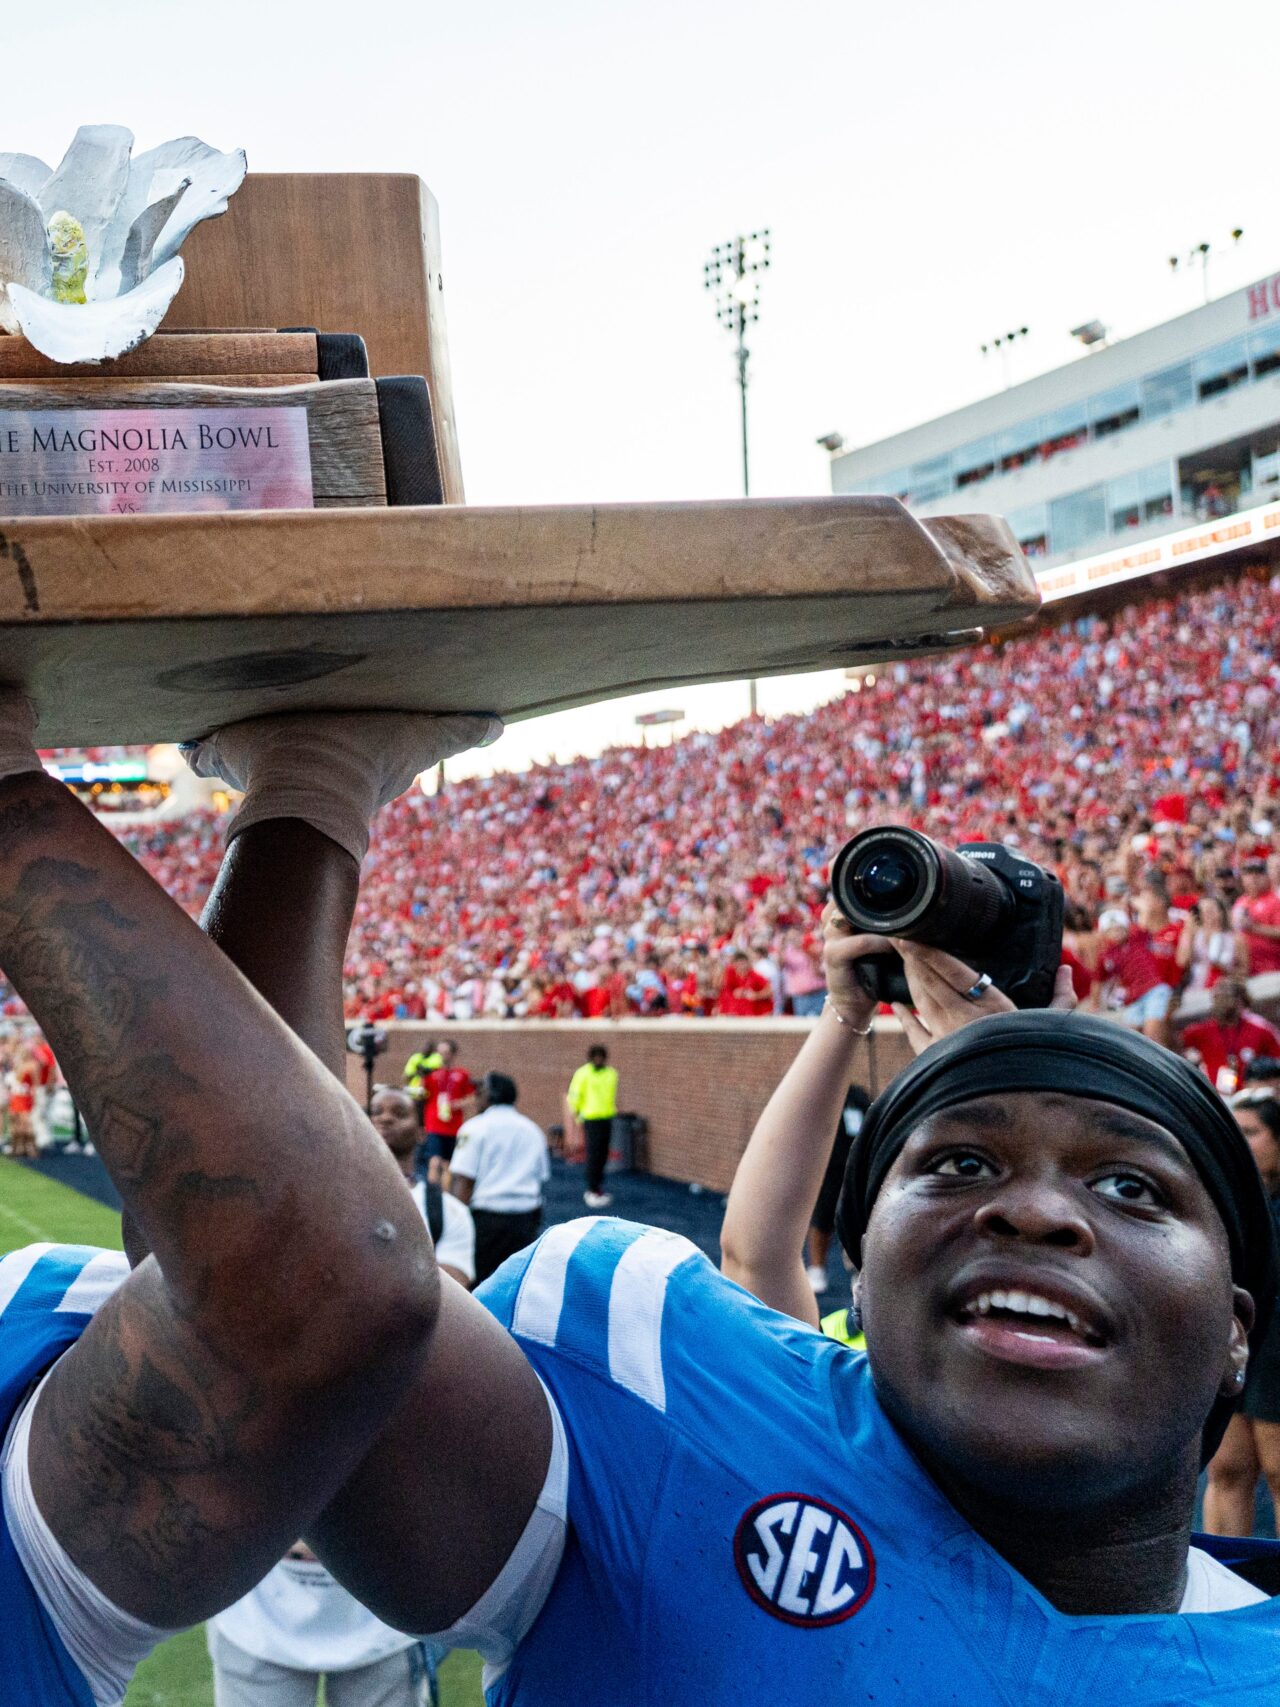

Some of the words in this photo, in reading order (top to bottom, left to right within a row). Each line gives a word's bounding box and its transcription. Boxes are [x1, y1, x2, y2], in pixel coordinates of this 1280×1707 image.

[32, 426, 189, 452] MAGNOLIA
[198, 424, 280, 450] BOWL
[88, 458, 119, 473] EST.
[124, 457, 160, 473] 2008
[34, 480, 130, 496] UNIVERSITY
[134, 480, 156, 494] OF
[161, 478, 252, 494] MISSISSIPPI
[960, 850, 996, 860] Canon
[1018, 869, 1035, 878] EOS
[1019, 879, 1033, 888] R3
[746, 1500, 864, 1617] SEC
